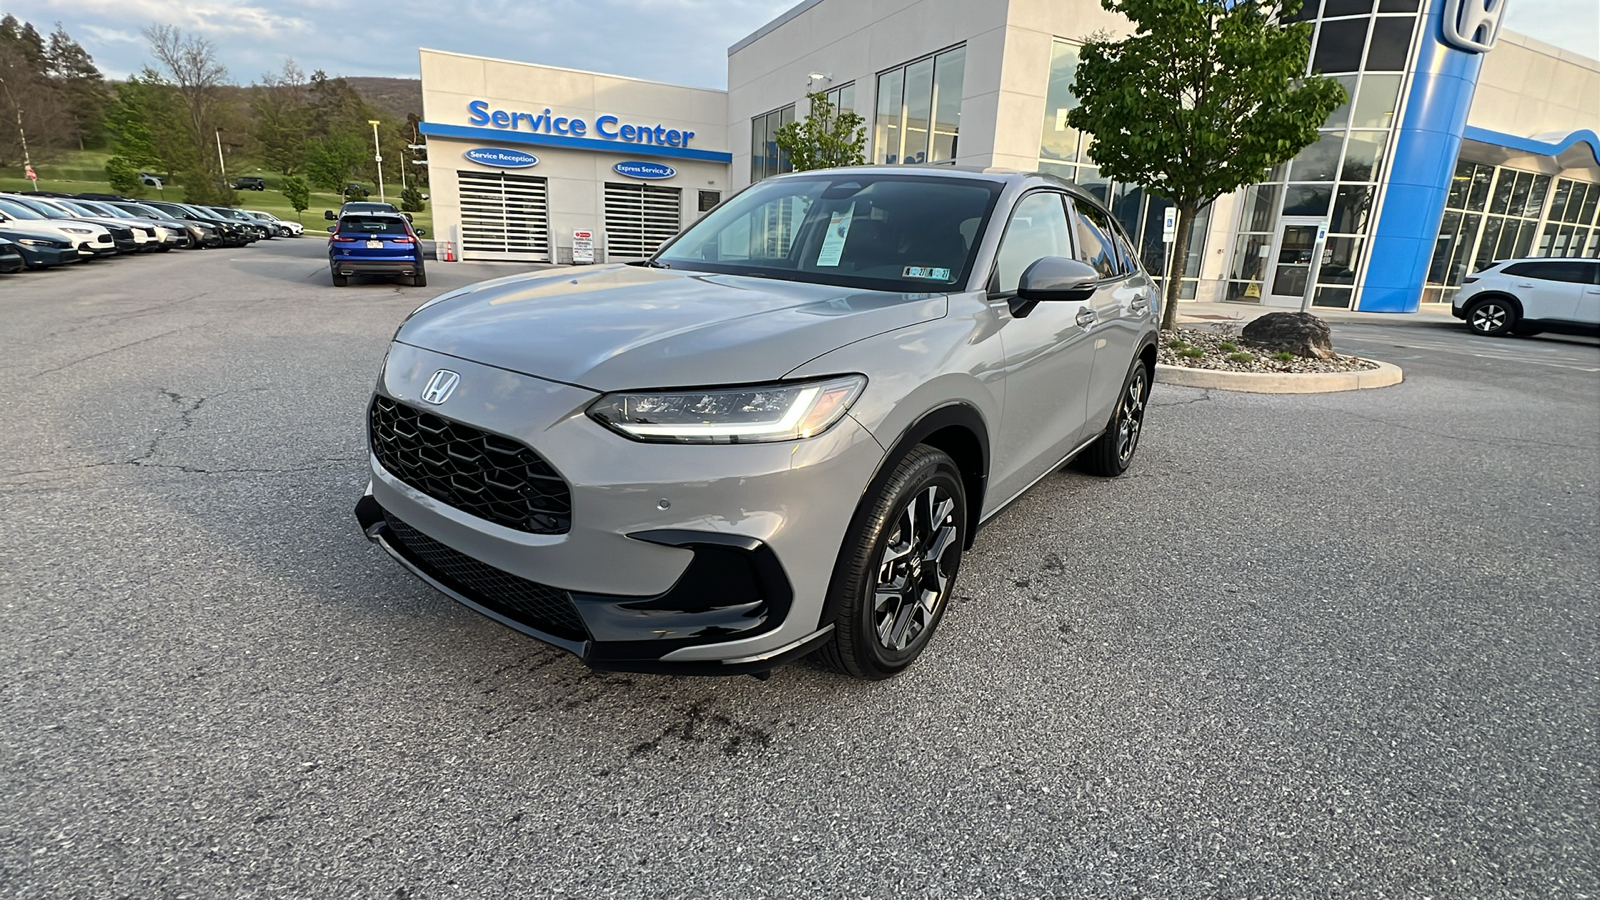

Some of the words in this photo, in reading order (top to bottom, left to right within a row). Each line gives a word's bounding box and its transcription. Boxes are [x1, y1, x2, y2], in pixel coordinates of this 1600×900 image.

[469, 100, 586, 136] Service
[595, 115, 696, 147] Center
[470, 151, 498, 160] Service
[498, 153, 534, 163] Reception
[617, 164, 641, 173] Express
[641, 166, 664, 174] Service
